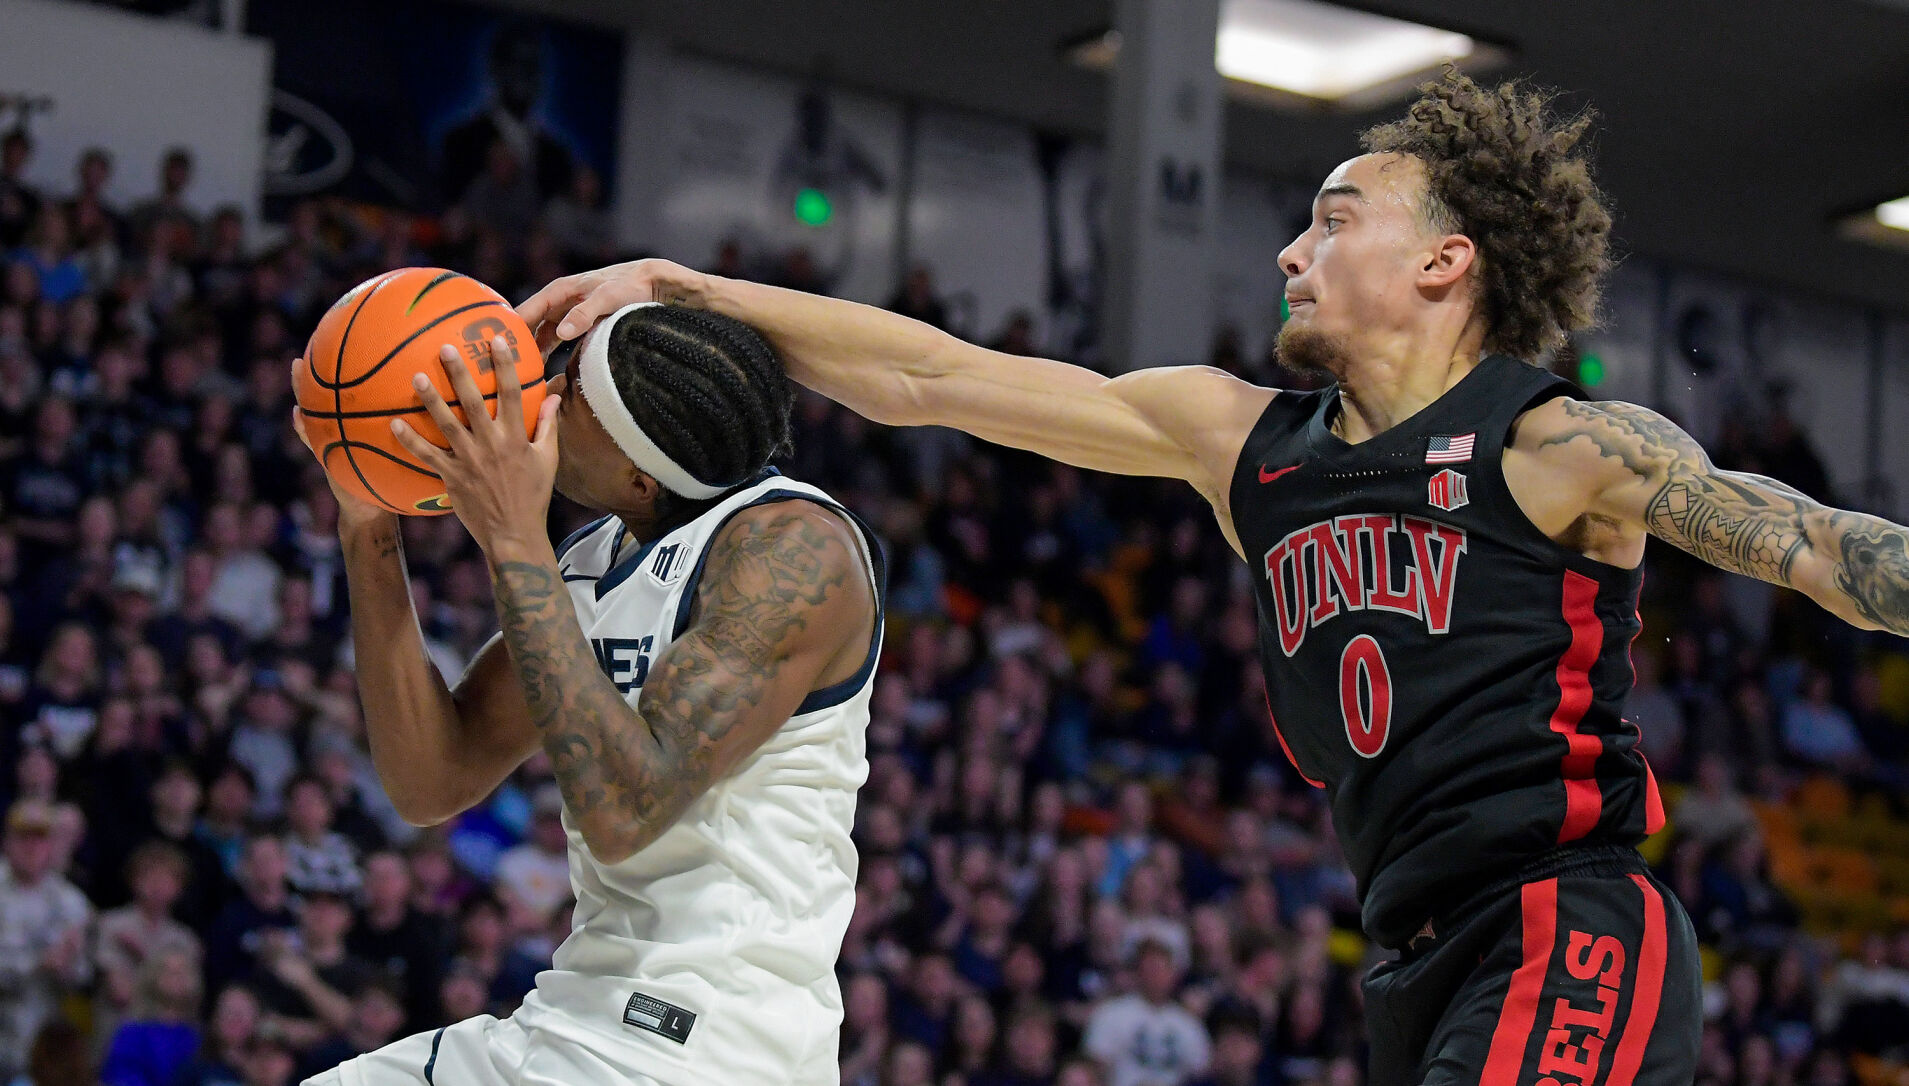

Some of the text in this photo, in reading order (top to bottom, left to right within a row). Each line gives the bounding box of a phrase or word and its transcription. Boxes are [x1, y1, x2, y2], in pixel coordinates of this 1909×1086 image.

[1264, 513, 1467, 657] UNLV
[1339, 633, 1393, 759] 0
[671, 1016, 679, 1030] L
[1535, 929, 1626, 1086] ELS
